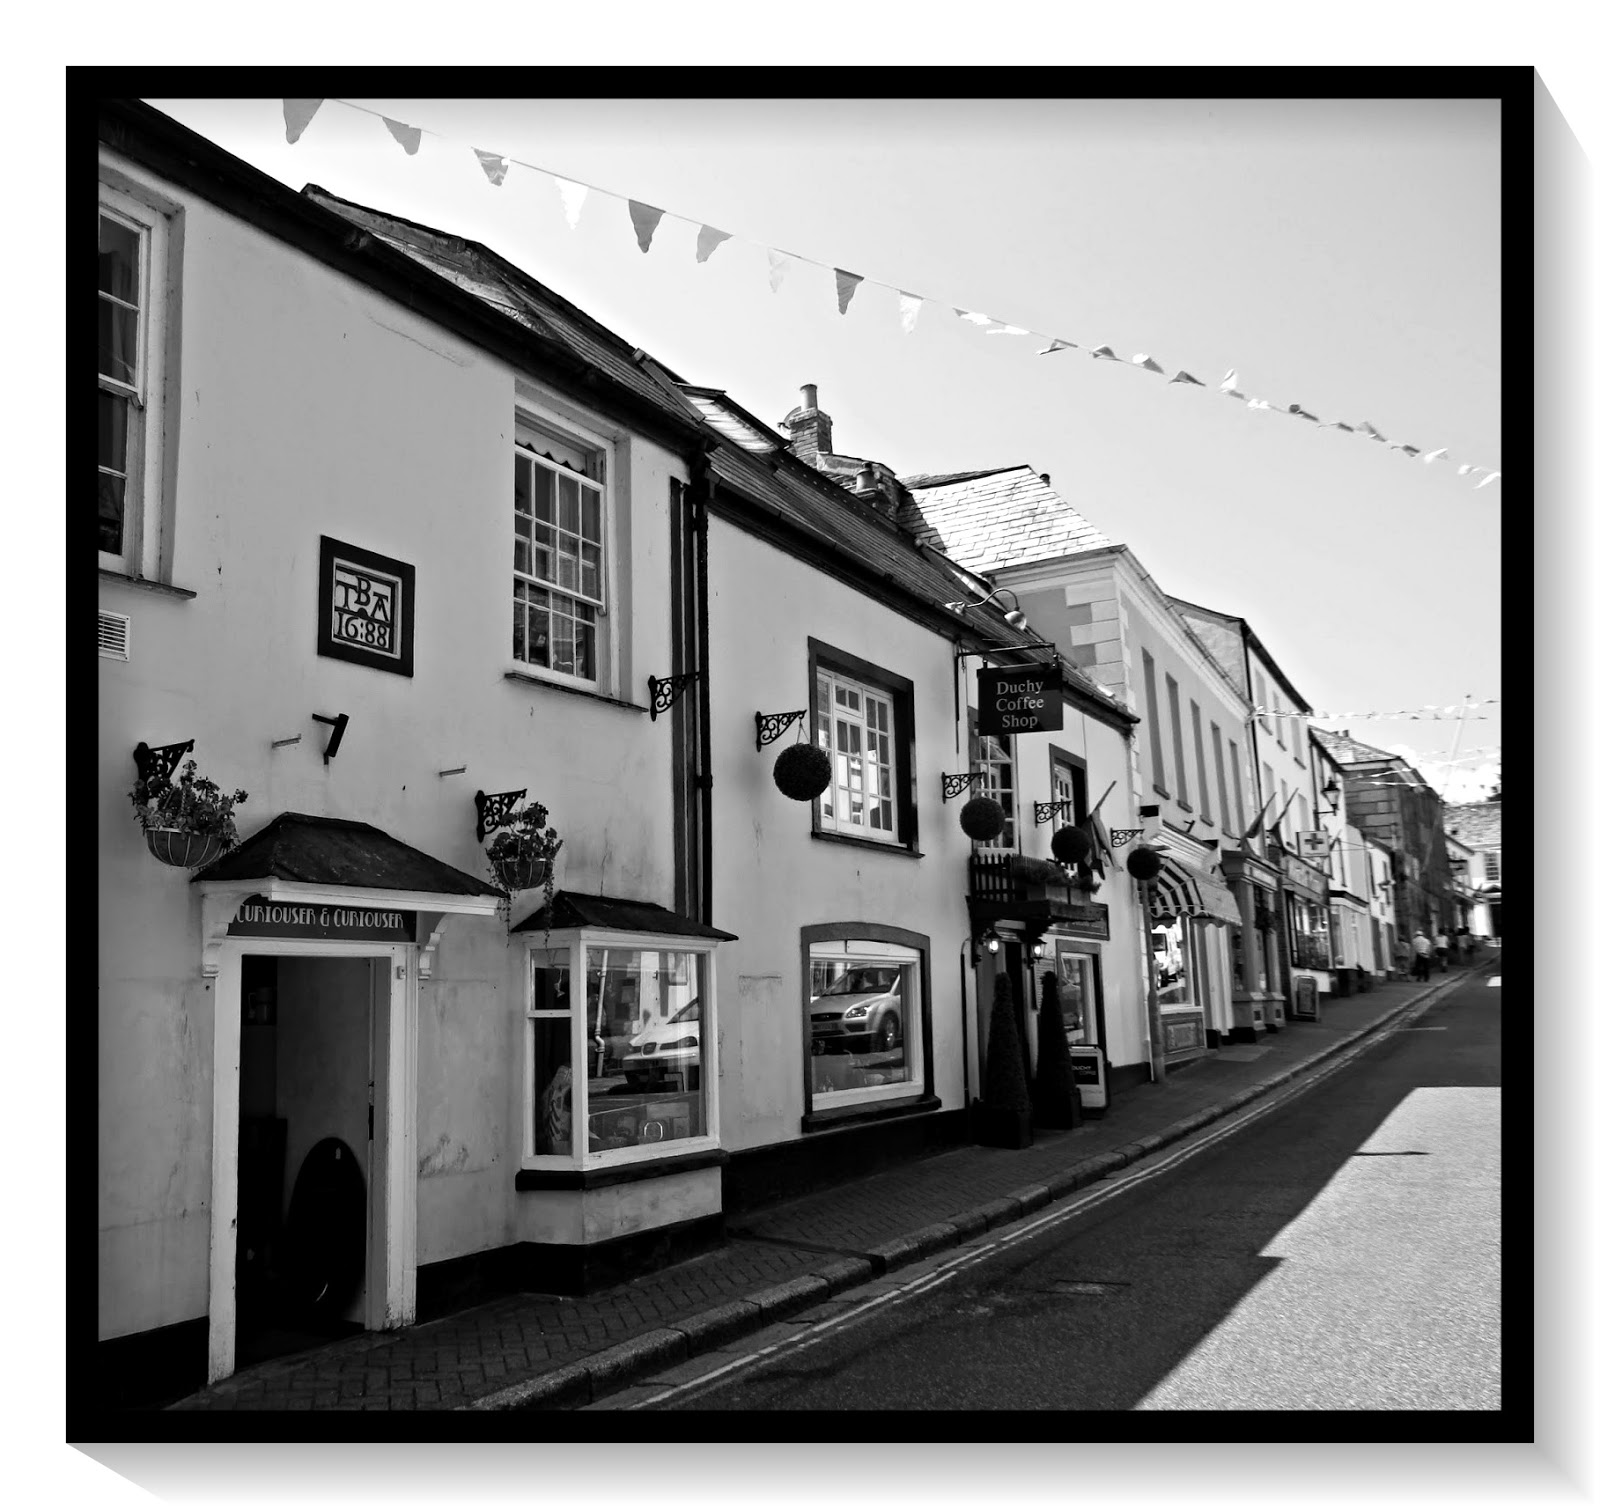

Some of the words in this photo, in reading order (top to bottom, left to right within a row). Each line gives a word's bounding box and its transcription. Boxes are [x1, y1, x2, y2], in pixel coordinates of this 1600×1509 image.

[996, 680, 1044, 695] Duchy
[995, 696, 1045, 712] Coffee
[1001, 714, 1039, 728] Shop
[236, 904, 316, 925] CURIOUSER
[320, 907, 330, 927] &
[333, 908, 404, 929] CURIOUSER
